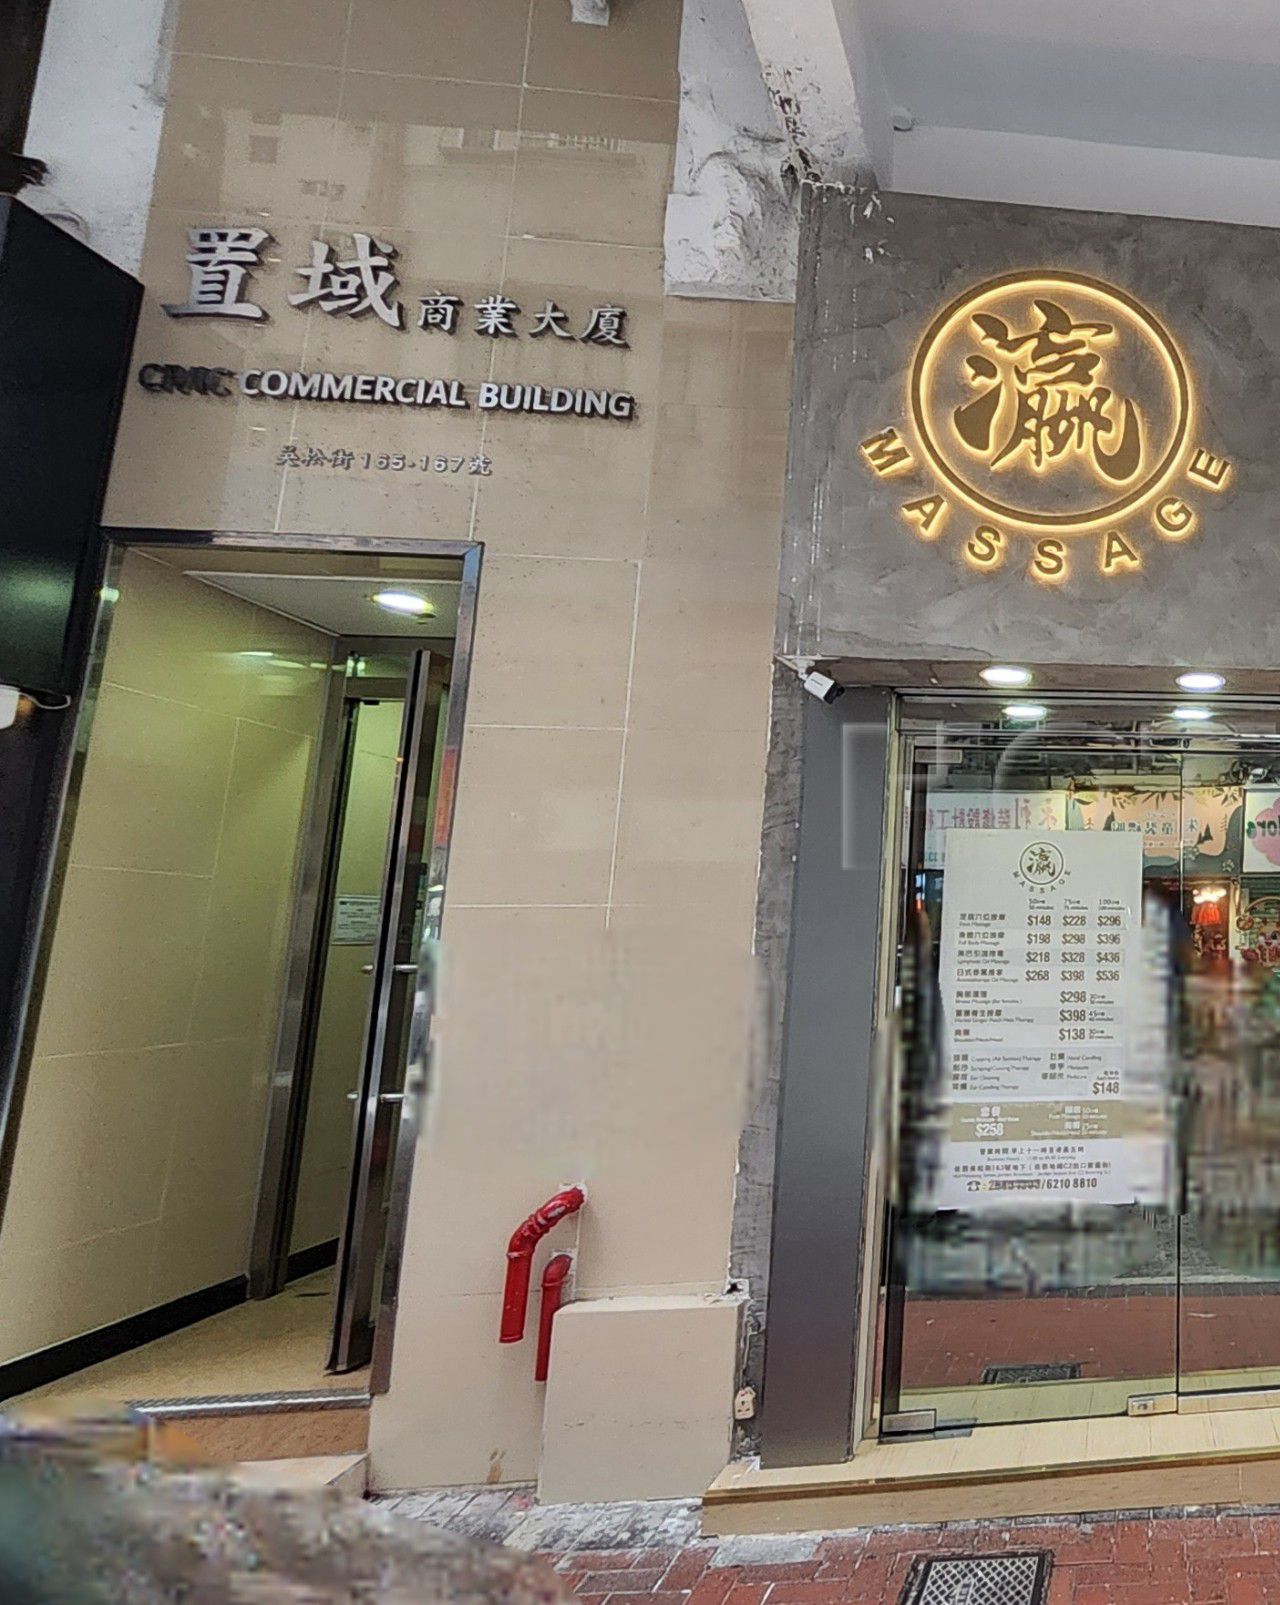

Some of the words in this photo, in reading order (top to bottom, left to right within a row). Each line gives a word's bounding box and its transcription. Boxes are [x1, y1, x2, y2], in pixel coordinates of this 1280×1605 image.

[161, 226, 631, 347] 置域商業大廈
[239, 369, 469, 411] COMMERCIAL
[478, 381, 637, 421] BUILDING
[861, 427, 1230, 575] MASSAGE
[1027, 914, 1051, 927] $148
[1062, 914, 1087, 927] $228
[1097, 914, 1121, 927] $296
[1026, 932, 1051, 945] $198
[1061, 932, 1086, 945] $298
[1096, 932, 1121, 945] $396
[1025, 951, 1050, 964] $218
[1061, 951, 1085, 964] $328
[1096, 951, 1120, 963] $436
[1025, 970, 1050, 982] $268
[1060, 970, 1085, 982] $398
[1095, 970, 1120, 982] $536
[1059, 991, 1087, 1004] $298
[1059, 1009, 1087, 1023] $398
[1058, 1028, 1086, 1041] $138
[1092, 1082, 1120, 1095] $148
